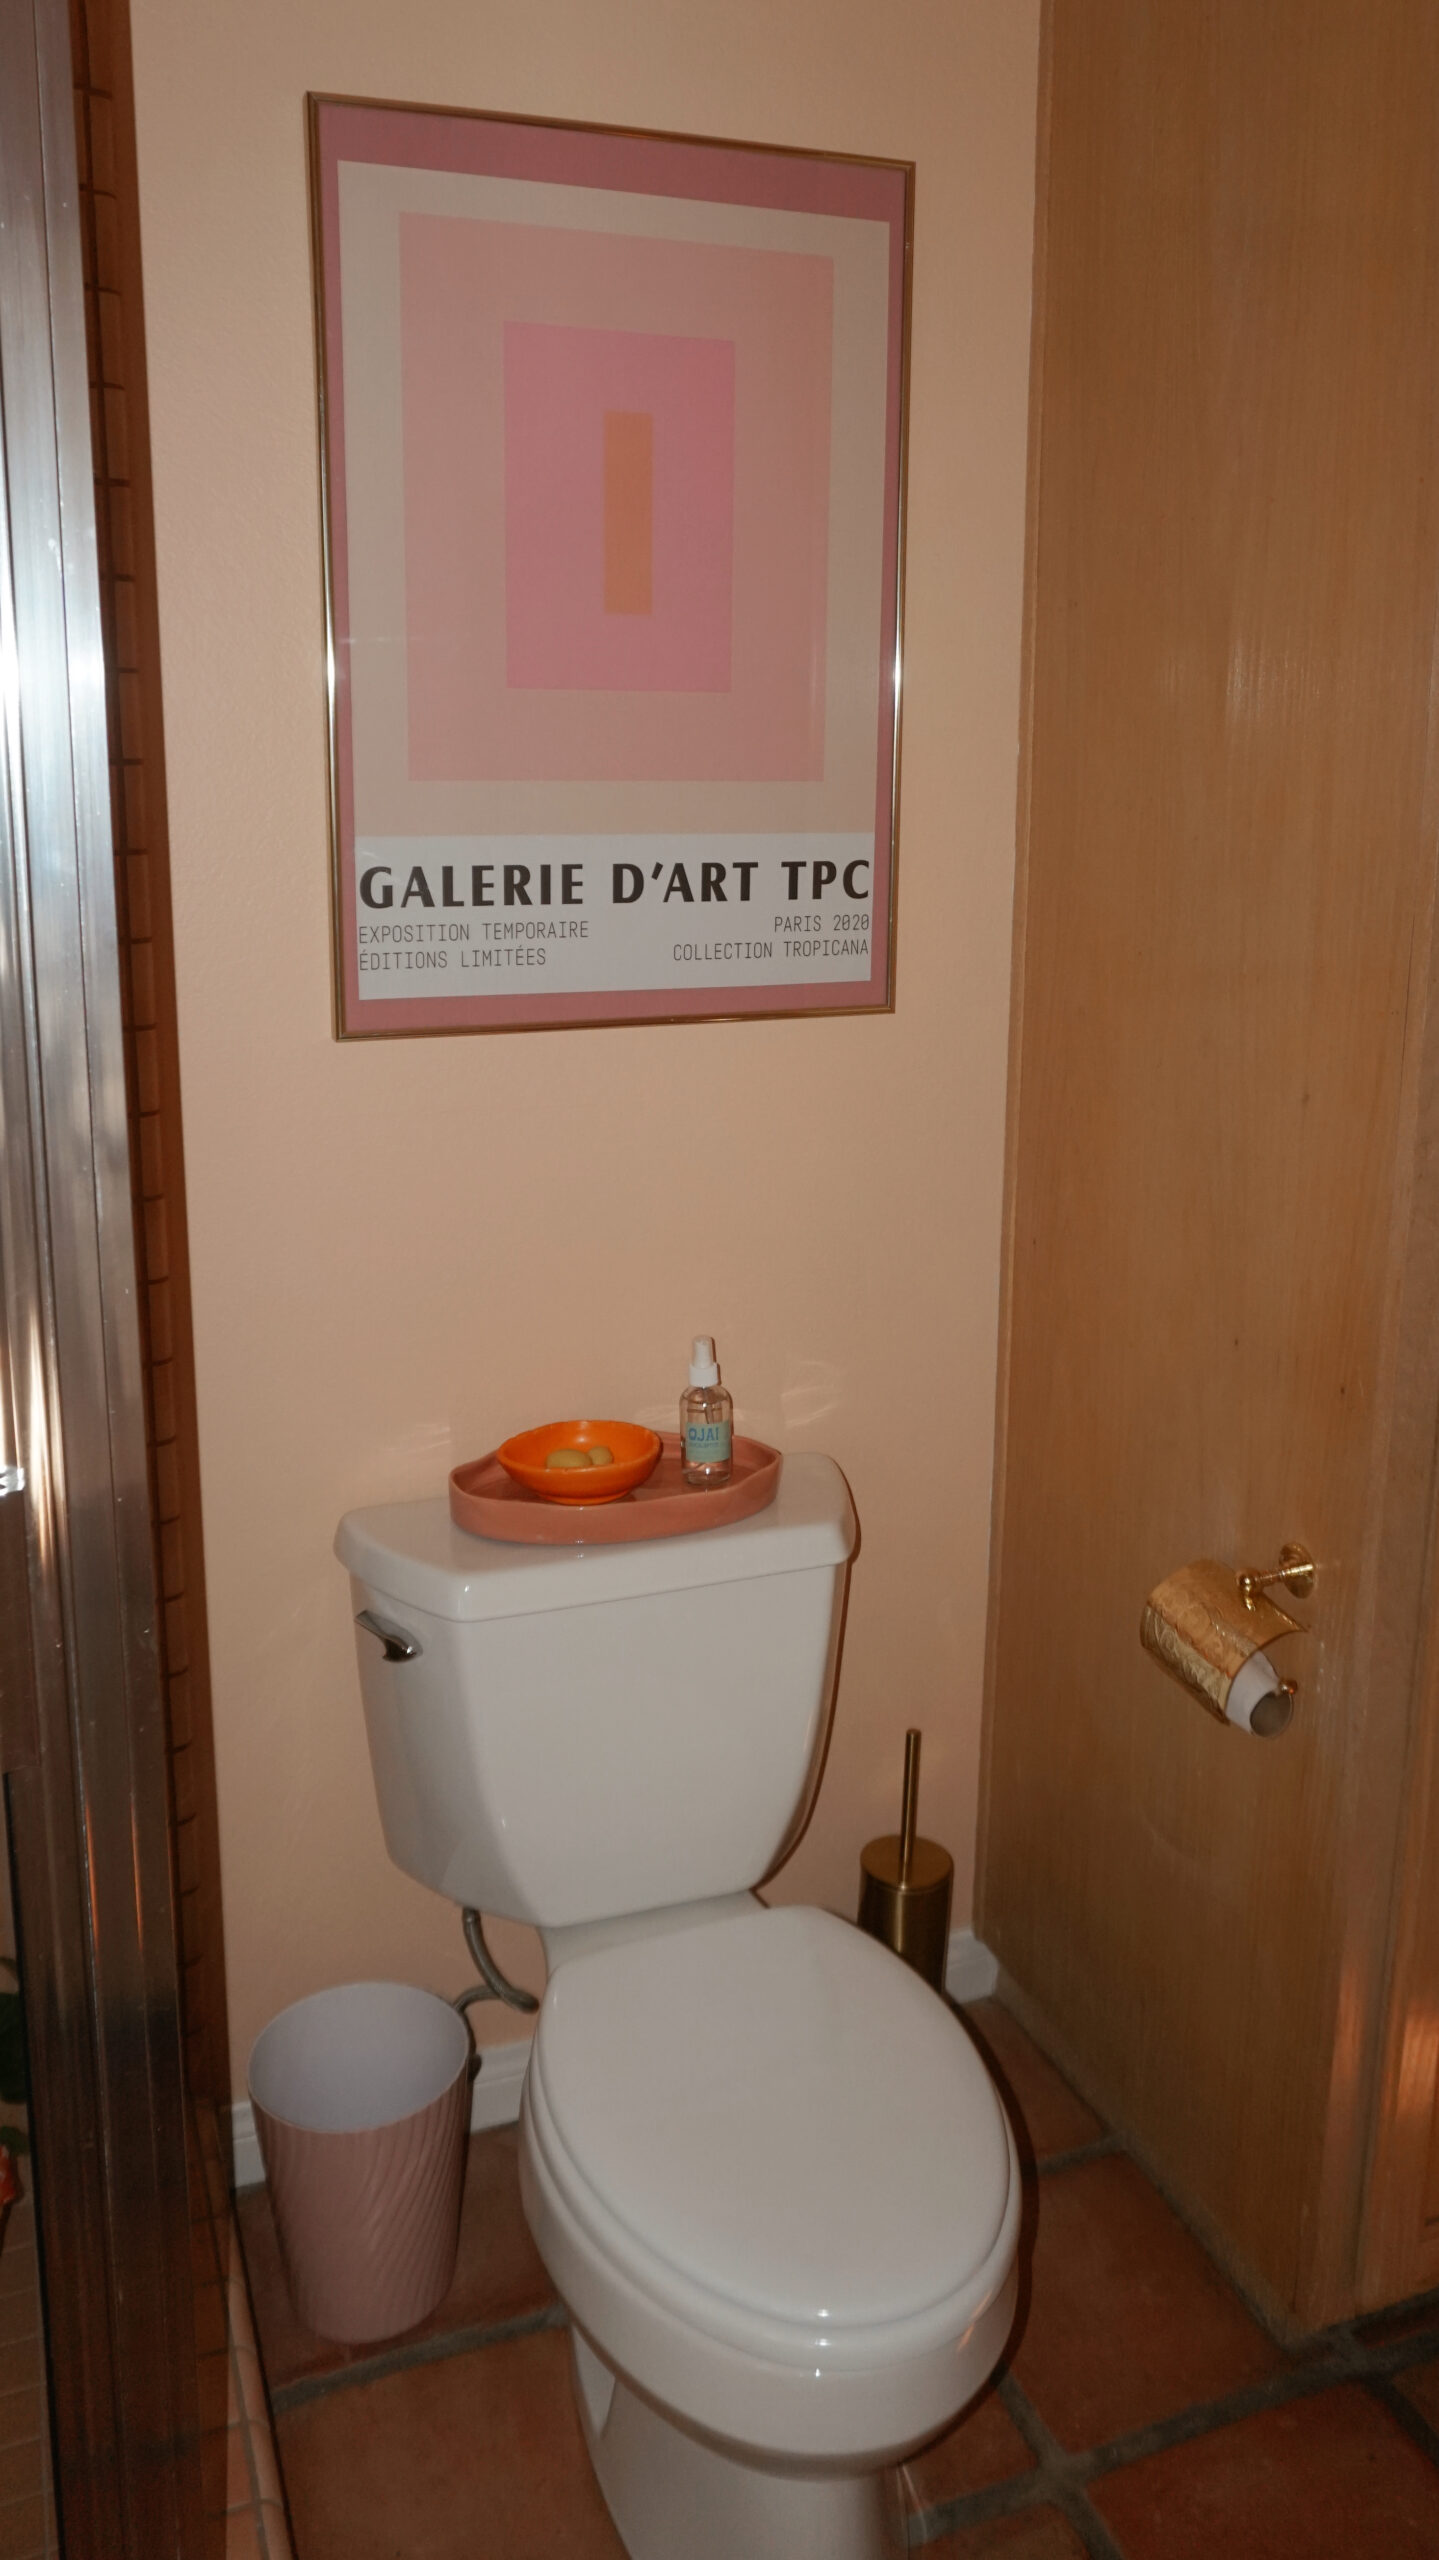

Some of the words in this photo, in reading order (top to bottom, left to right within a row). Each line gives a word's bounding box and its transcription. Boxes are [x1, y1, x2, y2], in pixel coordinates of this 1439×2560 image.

[359, 864, 584, 909] GALERIE
[781, 859, 870, 900] TPC
[359, 923, 470, 944] EXPOSITION
[482, 921, 590, 941] TEMPORAIRE
[774, 915, 822, 933] PARIS
[833, 913, 870, 931] 2020
[359, 950, 448, 971] ÉDITIONS
[461, 945, 547, 968] LIMITÉES
[673, 941, 773, 961] COLLECTION
[784, 938, 869, 958] TROPICANA
